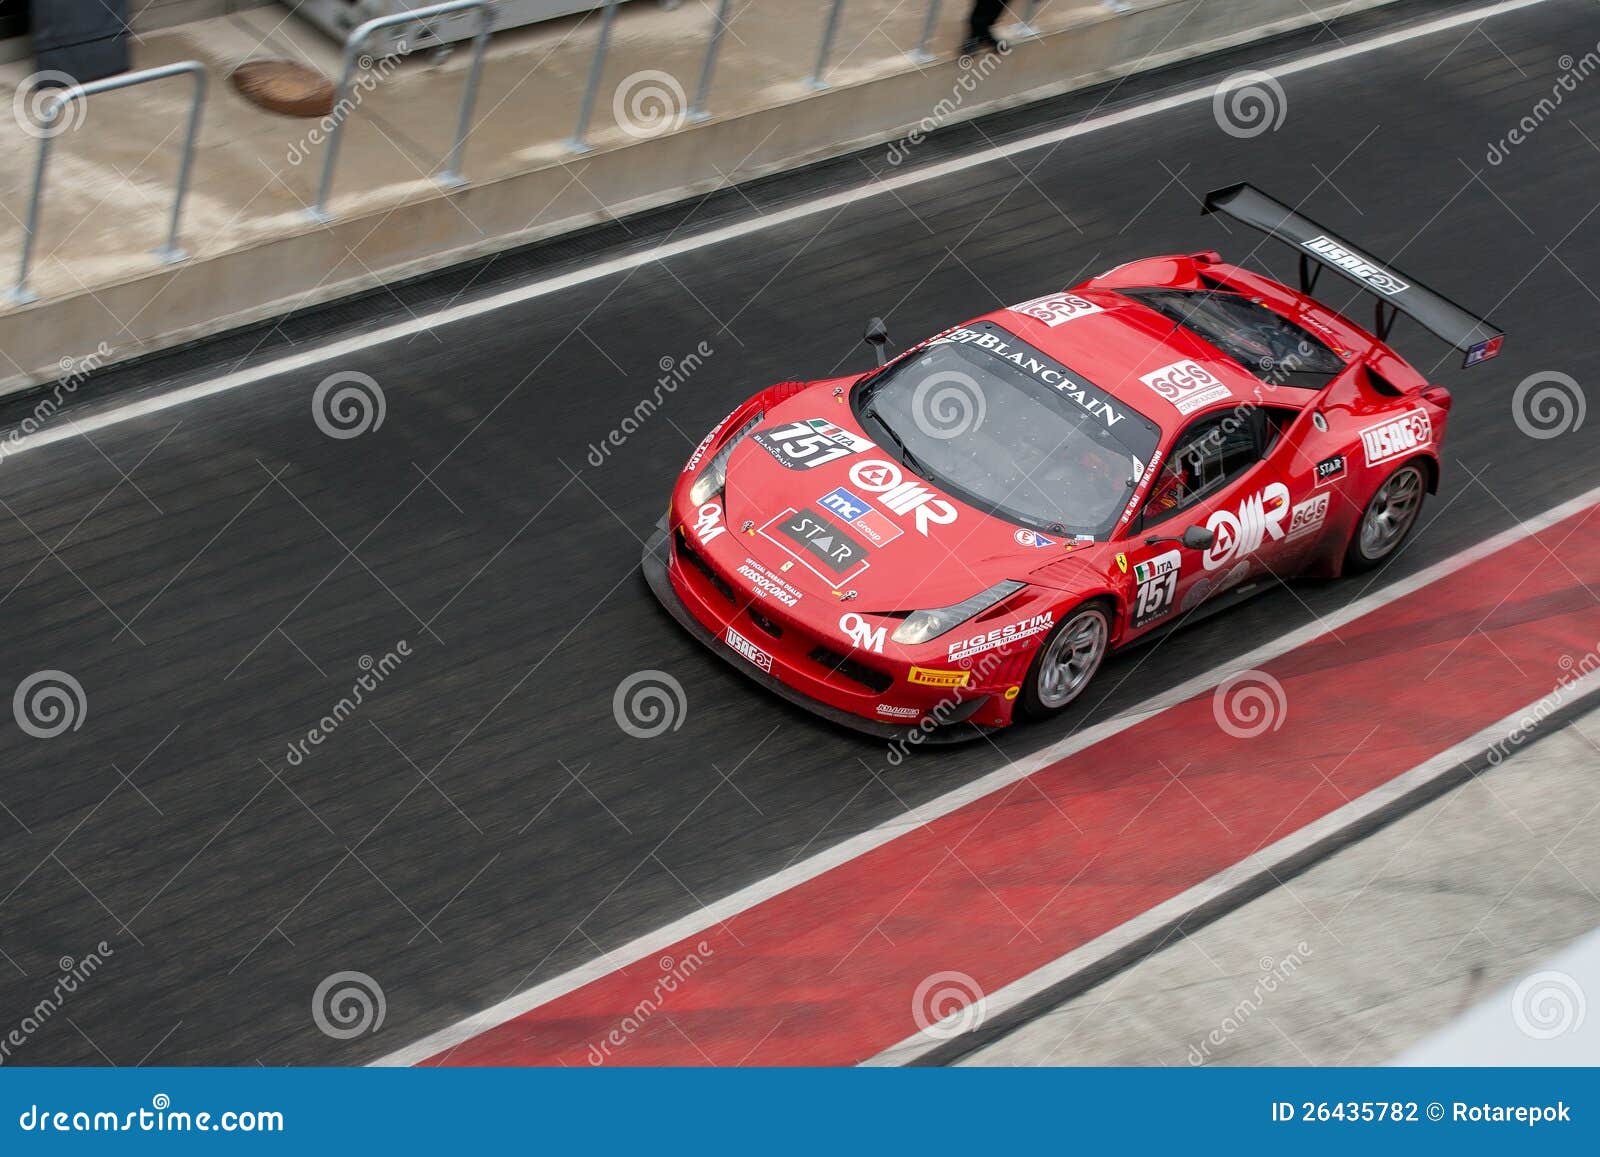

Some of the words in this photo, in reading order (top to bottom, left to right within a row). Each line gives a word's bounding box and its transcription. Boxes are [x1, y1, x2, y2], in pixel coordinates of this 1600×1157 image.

[1308, 239, 1380, 279] USAG
[1029, 296, 1092, 323] SGS
[972, 332, 1127, 428] BLANCPAIN
[1152, 364, 1213, 399] SGS
[753, 435, 794, 468] BLANCPAIN
[769, 422, 853, 468] 151
[831, 433, 856, 447] ITA
[1364, 418, 1417, 461] USAG
[1319, 459, 1342, 476] STAR
[824, 493, 862, 519] mc
[1291, 499, 1327, 530] SGS
[791, 518, 852, 563] STAR
[856, 519, 882, 541] Group
[1157, 560, 1173, 574] ITA
[736, 564, 798, 608] ROSSOCORSA
[752, 585, 768, 598] ITALY
[1136, 570, 1178, 618] 151
[728, 630, 758, 661] USAG
[948, 611, 1053, 655] FIGESTIM
